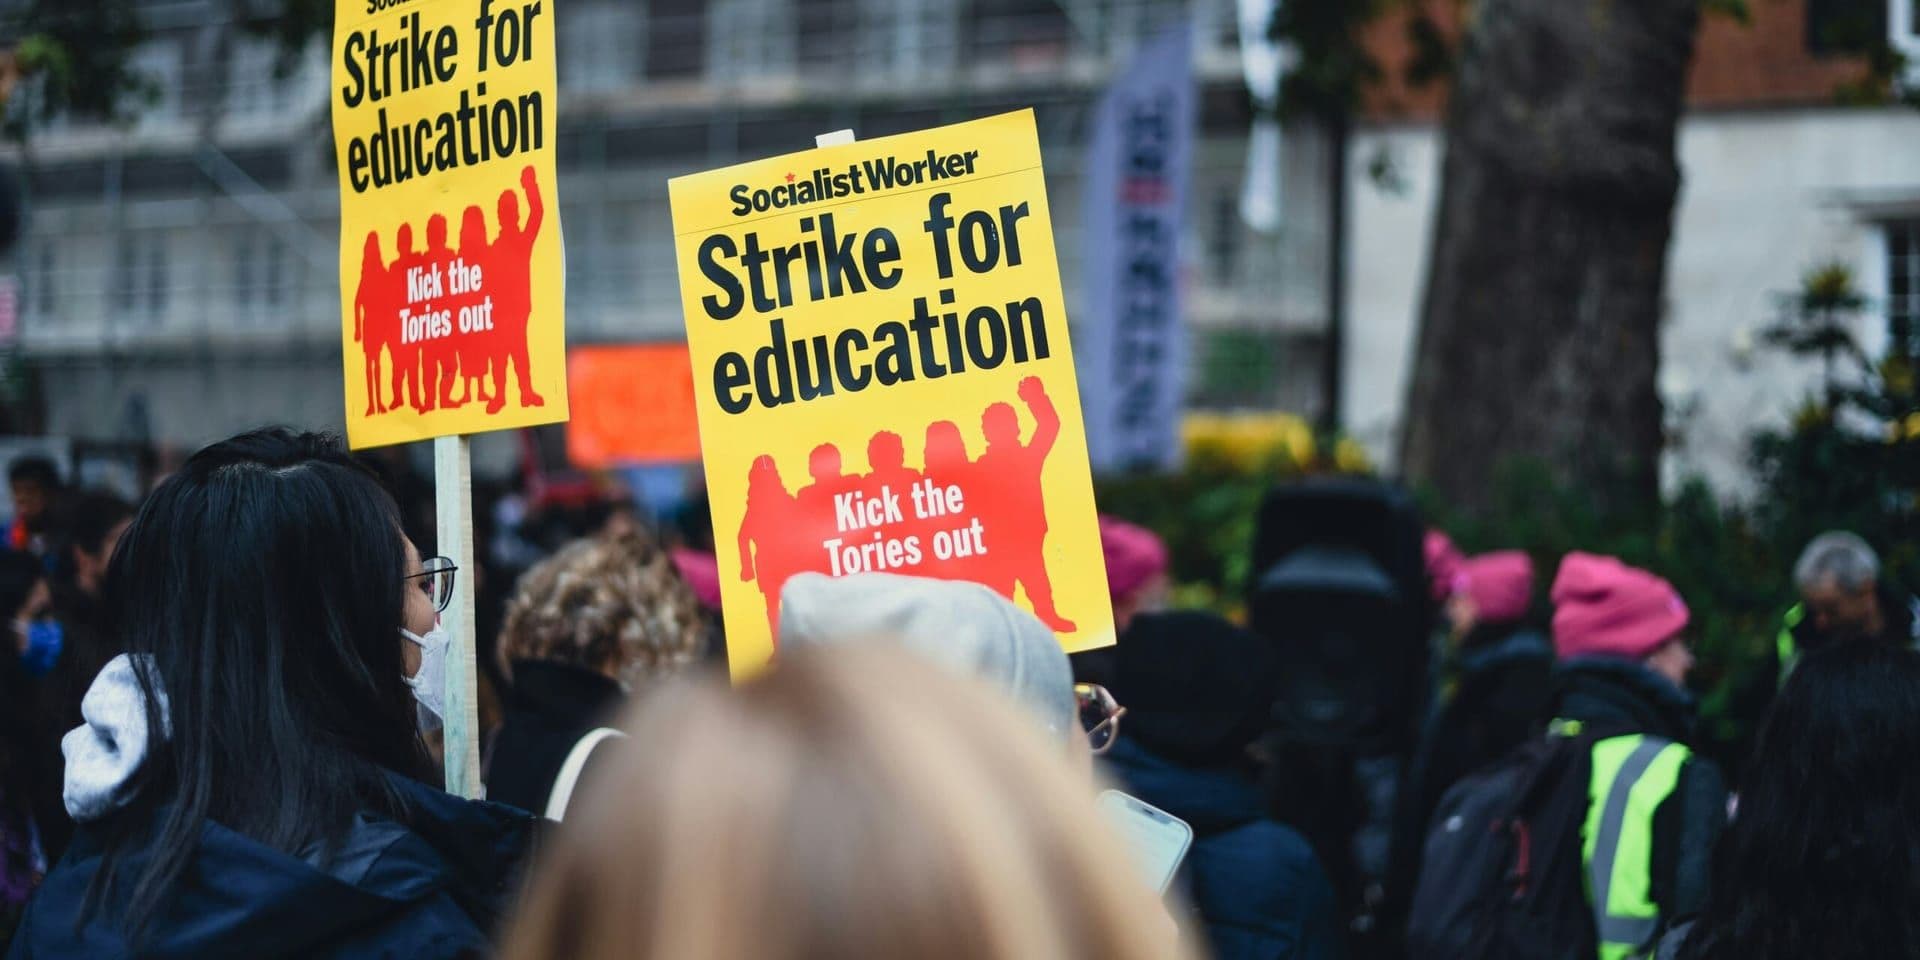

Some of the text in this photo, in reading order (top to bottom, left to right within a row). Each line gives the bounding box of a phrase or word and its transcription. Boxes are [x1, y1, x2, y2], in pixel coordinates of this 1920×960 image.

[342, 0, 541, 109] Strike for
[348, 82, 543, 194] education
[730, 150, 978, 217] Socialist Worker
[407, 257, 482, 304] Kick the
[697, 192, 1030, 321] Strike for
[399, 295, 494, 345] Tories out
[713, 288, 1050, 415] education
[833, 478, 964, 533] Kick the
[823, 517, 988, 577] Tories out
